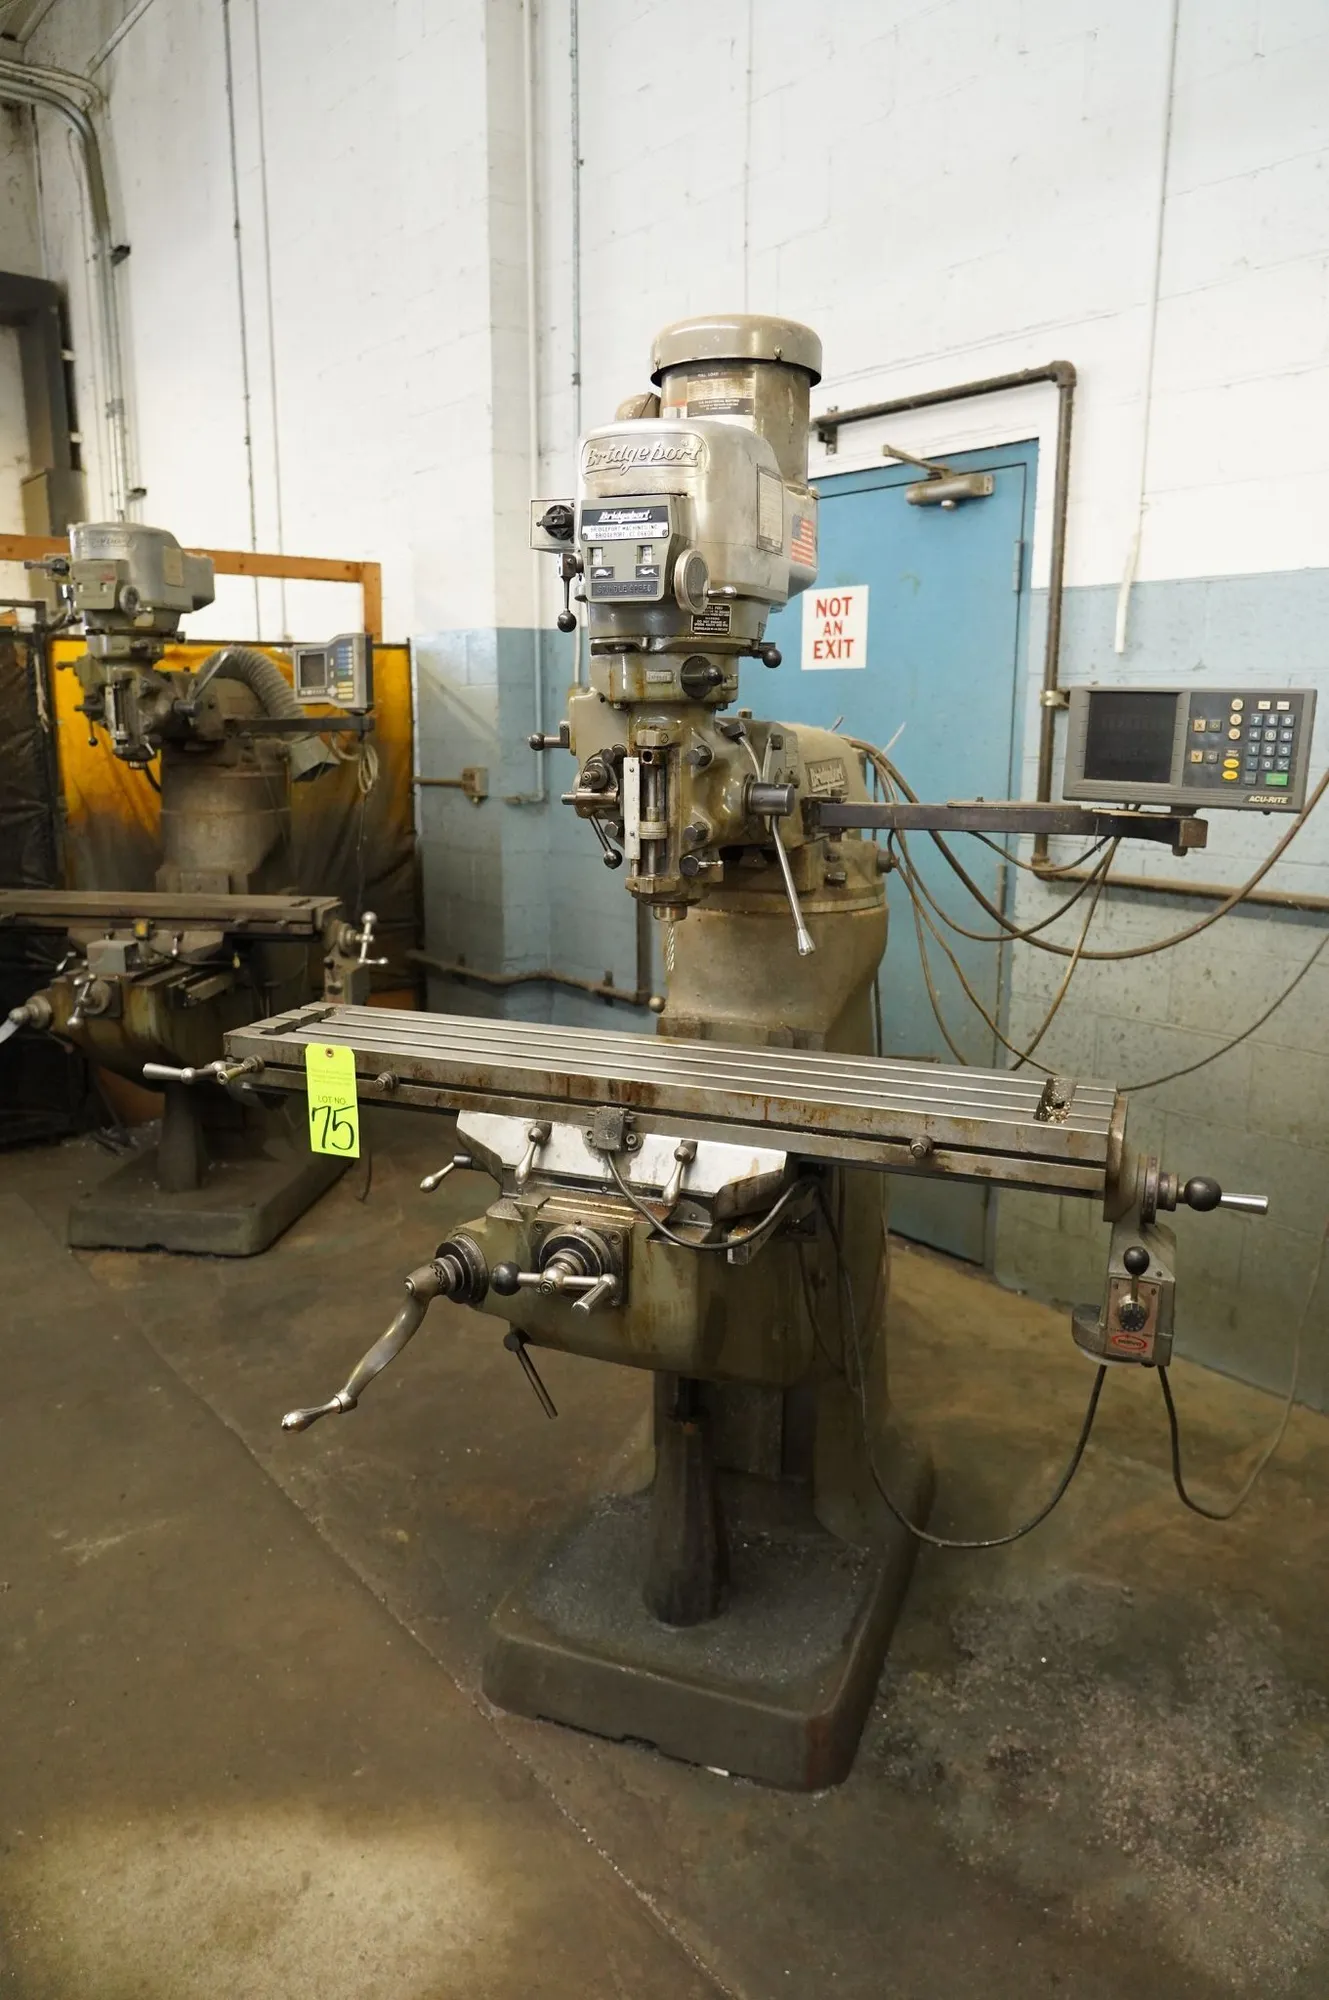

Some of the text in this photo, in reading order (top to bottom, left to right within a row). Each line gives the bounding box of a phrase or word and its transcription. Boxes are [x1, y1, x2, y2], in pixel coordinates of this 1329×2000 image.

[584, 441, 703, 476] Bridgeport
[816, 596, 853, 619] NOT
[823, 619, 843, 637] AN
[813, 638, 855, 660] EXIT
[1248, 795, 1289, 804] ACU-RITE
[317, 1095, 333, 1104] LOT
[311, 1105, 355, 1150] 75
